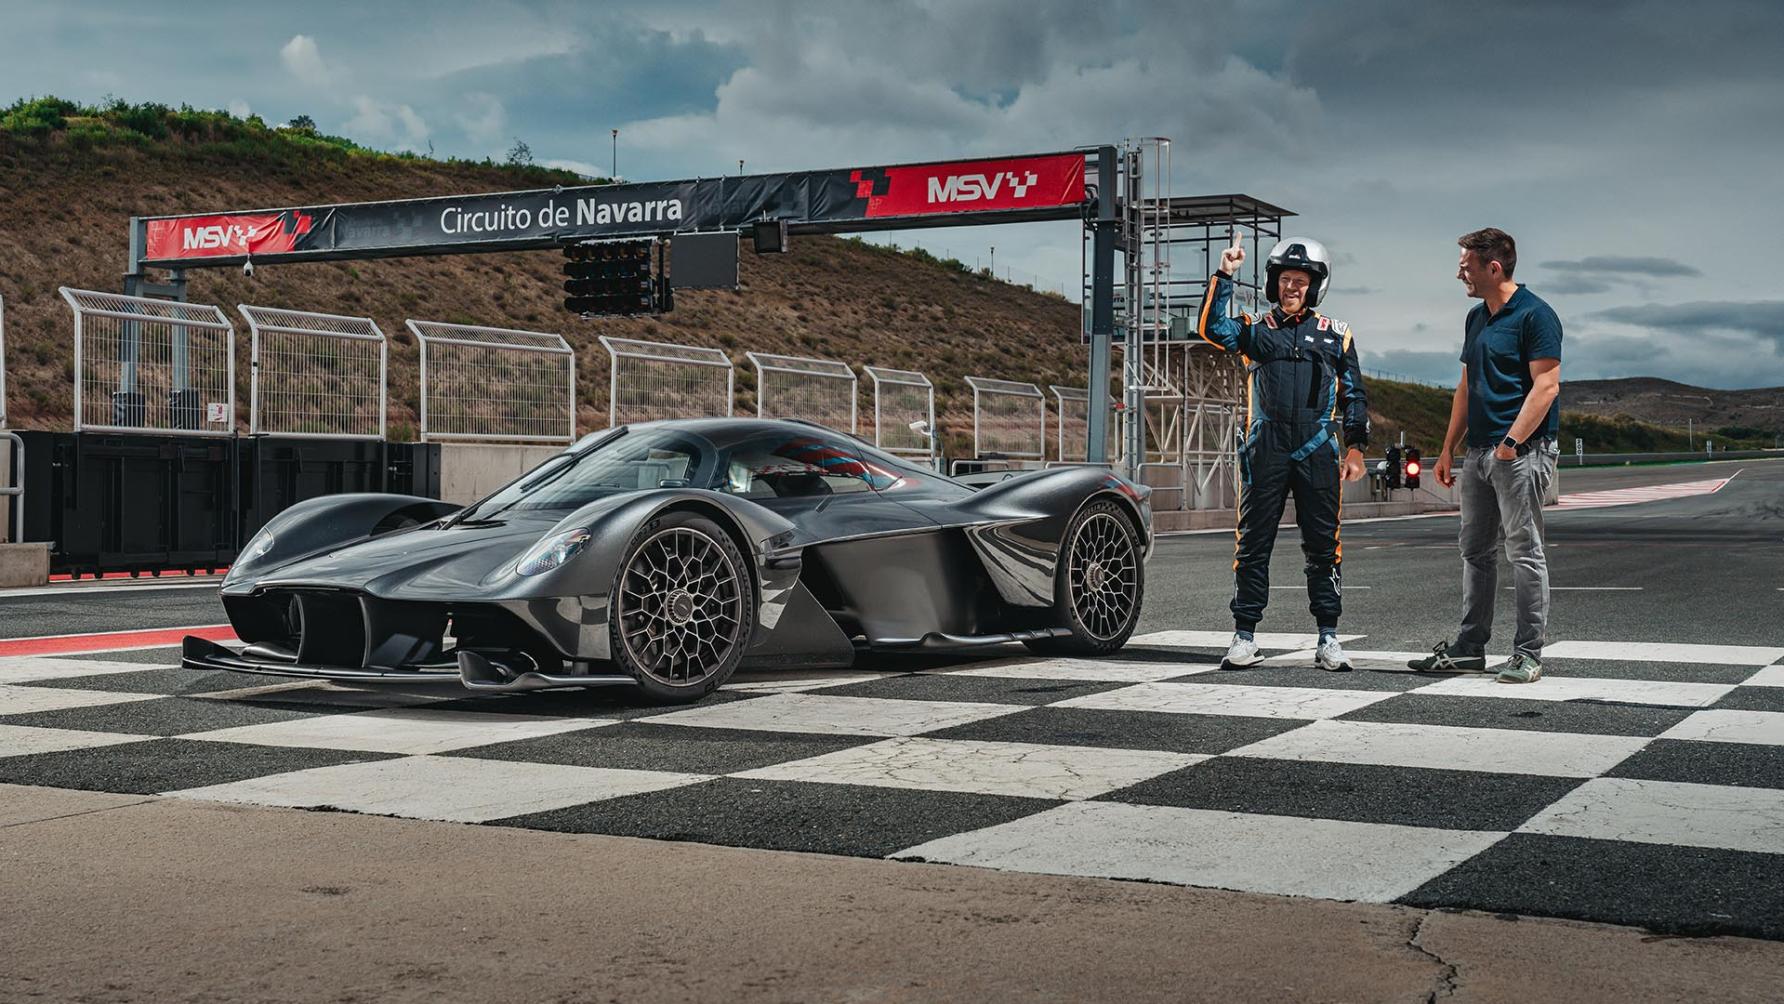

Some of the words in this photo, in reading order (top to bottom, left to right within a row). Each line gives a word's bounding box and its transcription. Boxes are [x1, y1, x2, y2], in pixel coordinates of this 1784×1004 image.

[928, 172, 1005, 204] MSV
[440, 204, 531, 234] Circuito
[538, 199, 570, 228] de
[576, 198, 683, 226] Navarra
[183, 225, 234, 250] MSV
